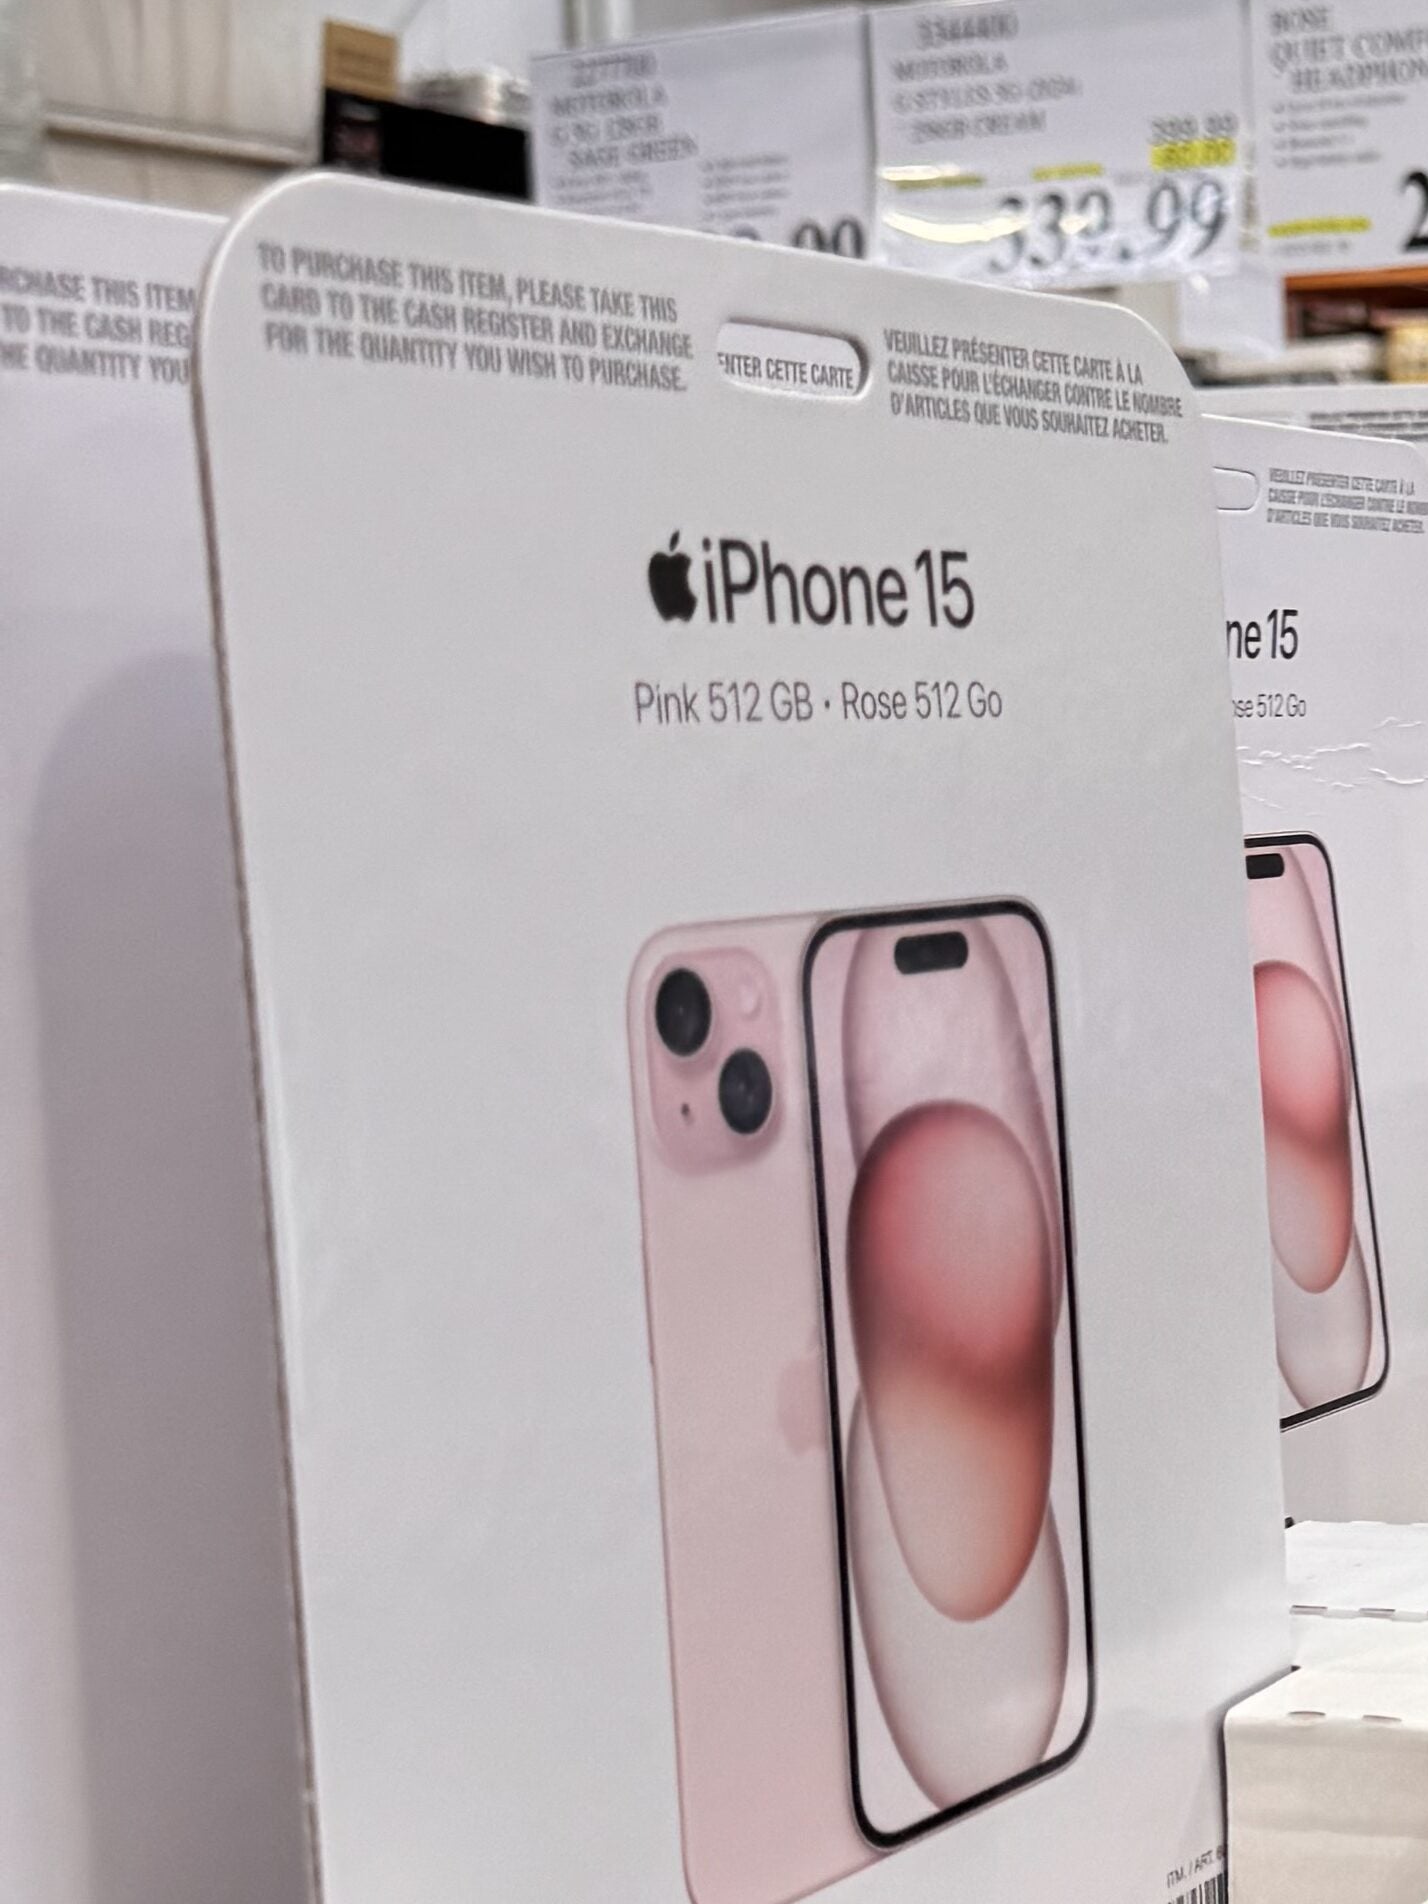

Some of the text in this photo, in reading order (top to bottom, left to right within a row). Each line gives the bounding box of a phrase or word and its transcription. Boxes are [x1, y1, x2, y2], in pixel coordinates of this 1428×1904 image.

[1270, 6, 1330, 32] BOSE
[1269, 35, 1345, 75] QUIET
[91, 276, 140, 308] THIS
[258, 241, 678, 324] TO PURCHASE THIS ITEM, PLEASE TAKE THIS
[37, 307, 79, 338] THE
[84, 311, 143, 344] CASH
[259, 282, 695, 360] CARD TO THE CASH REGISTER AND EXCHANGE
[264, 321, 689, 392] FOR THE QUANTITY YOU WISH TO PURCHASE.
[766, 358, 854, 391] CETTE CARTE
[884, 328, 1143, 385] VEUILLEZ PRÉSENTER CETTE CARTE À LA
[888, 360, 1184, 418] CAISSE POUR L'ÉCHANGER CONTRE LE NOMBRE
[890, 392, 1169, 445] D'ARTICLES QUE VOUS SOUHAITEZ ACHETER.
[702, 537, 975, 629] iPhone 15
[1267, 608, 1299, 660] 15
[634, 680, 1002, 725] Pink 512 GB Rose 512 Go
[1257, 693, 1284, 718] 512
[1286, 694, 1307, 718] Go
